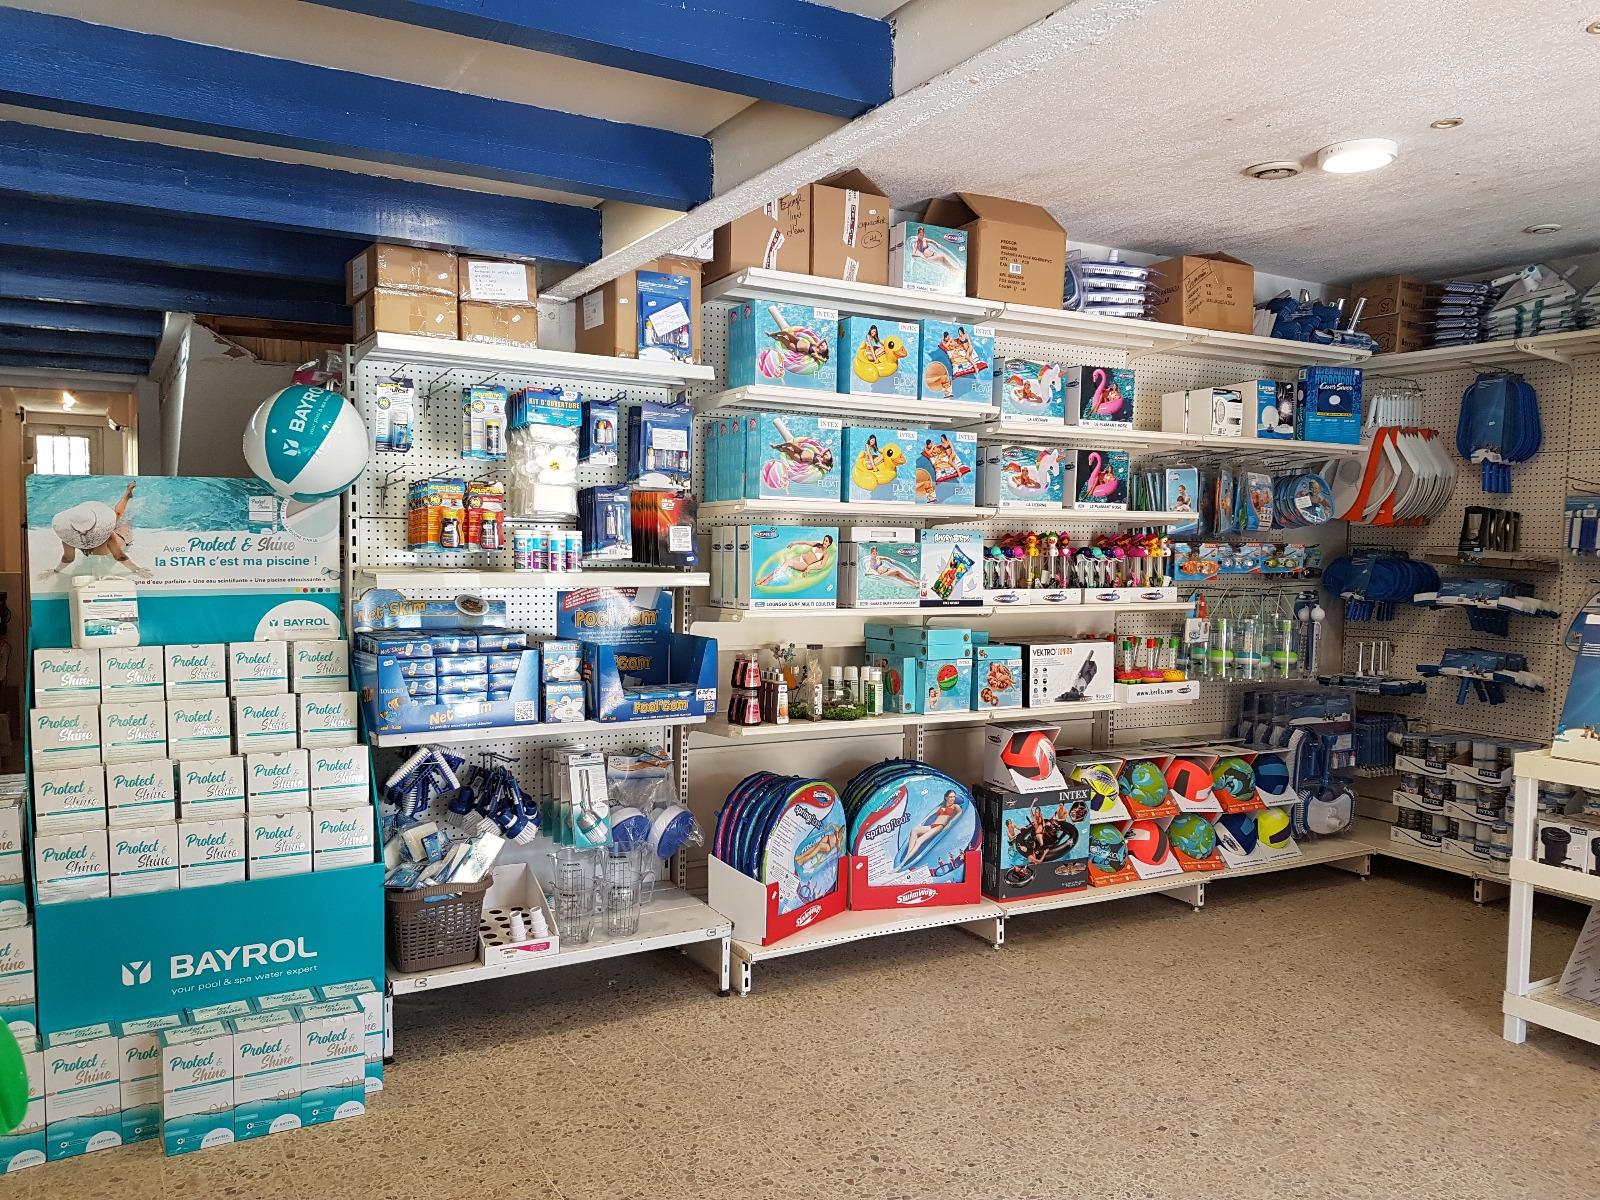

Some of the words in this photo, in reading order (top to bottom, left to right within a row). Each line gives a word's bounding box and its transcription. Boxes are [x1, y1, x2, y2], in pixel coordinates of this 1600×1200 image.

[816, 311, 835, 319] INTEX
[900, 324, 917, 332] INTEX
[975, 328, 992, 336] INTEX
[1314, 374, 1357, 385] HYDROTOOLS
[1320, 382, 1337, 390] Cover
[1336, 383, 1353, 391] Saver
[289, 387, 325, 432] BAYRO
[529, 398, 541, 407] KIT
[542, 400, 580, 410] D'OUVERTURE
[817, 480, 839, 488] FLOAT
[163, 545, 186, 553] Avec
[188, 537, 236, 552] Protect
[241, 538, 253, 552] &
[258, 537, 296, 551] Shine
[934, 534, 952, 543] ANGRY
[953, 535, 971, 543] BIRDS
[155, 557, 166, 567] la
[170, 557, 205, 567] STAR
[209, 556, 238, 566] c'est
[243, 558, 263, 567] ma
[267, 557, 310, 568] piscine
[284, 618, 330, 627] BAYROL
[236, 652, 271, 664] Protect
[298, 651, 333, 662] Protect
[1032, 648, 1056, 657] VEKTRO
[41, 660, 82, 673] Protect
[107, 657, 145, 670] Protect
[172, 654, 209, 667] Protect
[1135, 688, 1174, 697] www.kerlis.com
[243, 706, 279, 718] Protect
[306, 703, 342, 715] Protect
[633, 699, 689, 714] Pool'Gom
[38, 715, 81, 729] Protect
[108, 714, 148, 727] Protect
[174, 710, 212, 722] Protect
[254, 763, 291, 777] Protect
[317, 758, 353, 772] Protect
[1426, 761, 1443, 769] INTEX
[114, 773, 155, 788] Protect
[187, 770, 226, 785] Protect
[1479, 769, 1497, 778] INTEX
[41, 781, 85, 796] Protect
[1059, 789, 1089, 801] INTEX
[794, 804, 822, 830] springfloat
[1478, 808, 1495, 816] INTEX
[255, 825, 294, 840] Protect
[320, 819, 357, 834] Protect
[865, 813, 911, 840] springfloat
[186, 832, 227, 847] Protect
[1421, 833, 1438, 841] INTEX
[42, 845, 87, 862] Protect
[116, 839, 159, 855] Protect
[897, 889, 938, 904] SwimWays
[796, 905, 822, 927] SwimWays
[170, 936, 318, 980] BAYROL
[171, 984, 195, 995] your
[198, 980, 221, 991] pool
[223, 978, 232, 986] &
[234, 976, 252, 985] spa
[254, 971, 283, 981] water
[286, 965, 318, 976] expert
[307, 1028, 347, 1047] Protect
[126, 1045, 160, 1062] Prote
[240, 1039, 283, 1058] Protect
[326, 1042, 358, 1057] Shine
[52, 1054, 98, 1074] Protect
[170, 1052, 214, 1071] Protect
[261, 1055, 294, 1069] Shine
[75, 1070, 111, 1085] Shine
[192, 1068, 226, 1083] Shine
